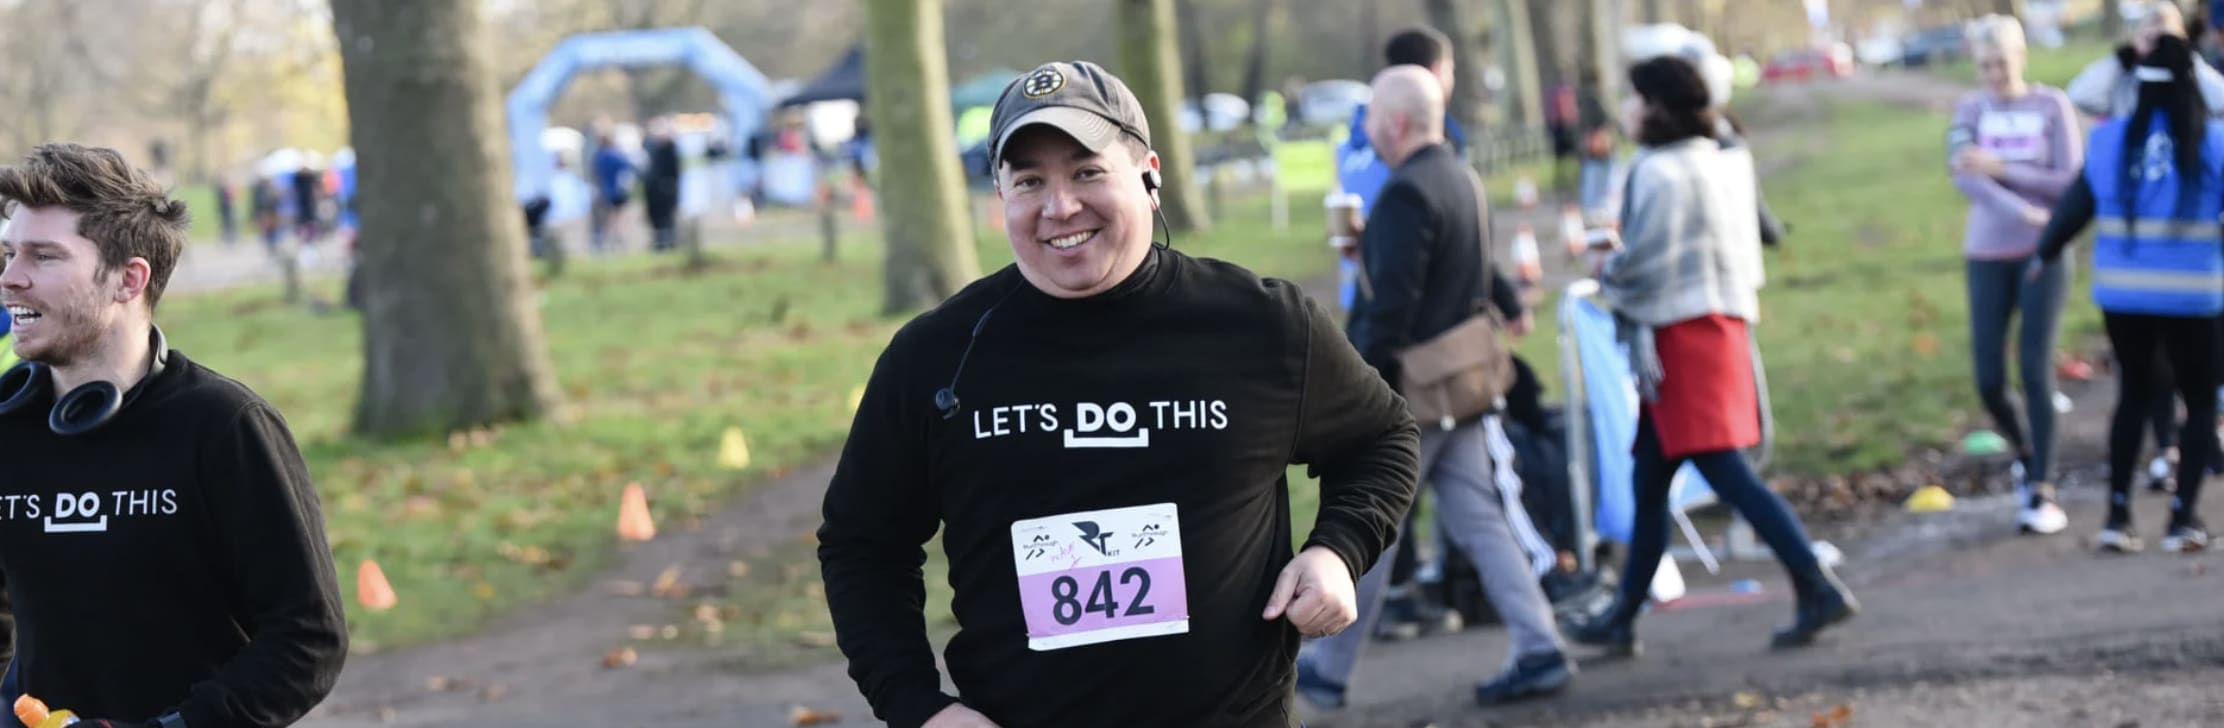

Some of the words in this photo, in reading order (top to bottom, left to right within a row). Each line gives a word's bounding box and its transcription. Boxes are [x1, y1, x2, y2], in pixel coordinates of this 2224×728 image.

[973, 403, 1059, 439] LET'S
[1076, 402, 1137, 432] DO
[1149, 400, 1228, 430] THIS
[0, 494, 40, 520] T'S
[55, 491, 101, 518] DO
[111, 489, 178, 516] THIS
[1051, 566, 1156, 626] 842
